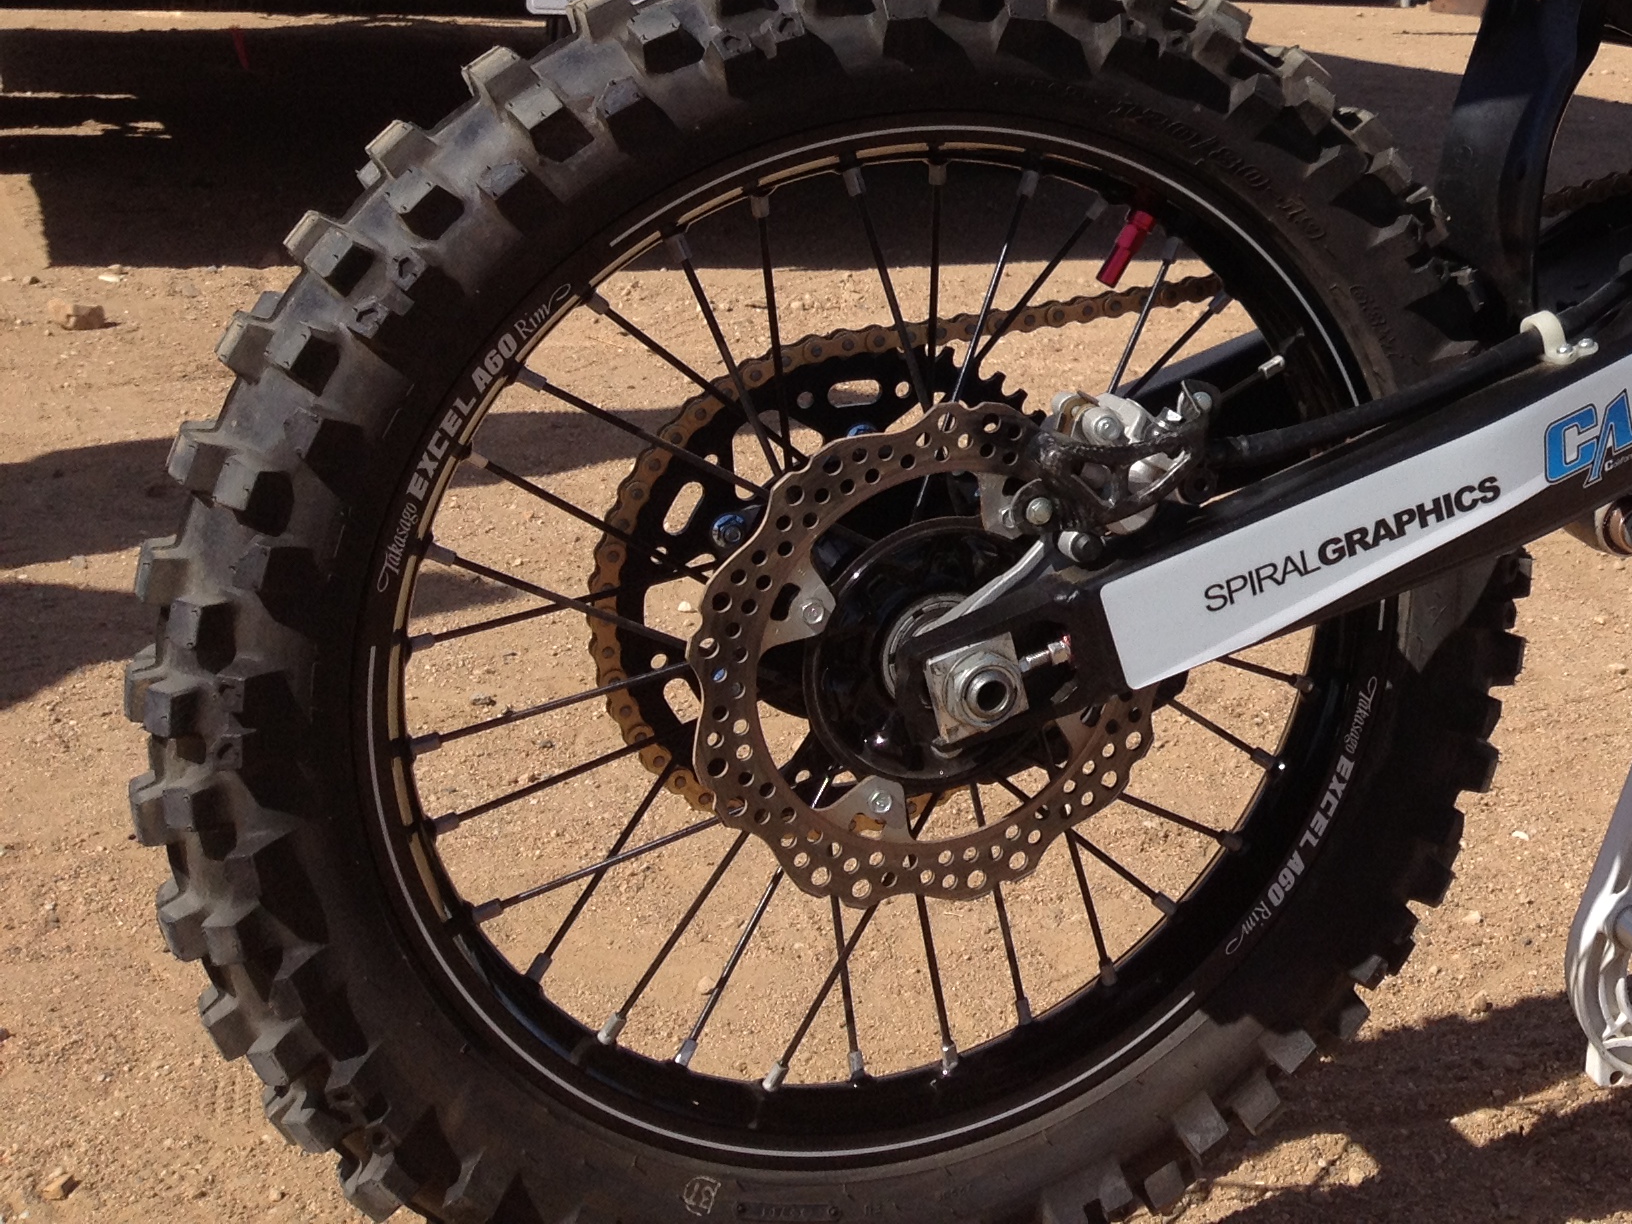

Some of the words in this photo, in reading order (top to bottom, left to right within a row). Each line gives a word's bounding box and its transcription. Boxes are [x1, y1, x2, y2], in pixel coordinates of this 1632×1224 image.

[405, 395, 477, 502] EXCEL
[470, 332, 518, 394] A60
[513, 283, 572, 342] Rim
[1299, 755, 1356, 848] EXCEL
[1267, 850, 1307, 908] A60
[1224, 900, 1273, 956] Rim
